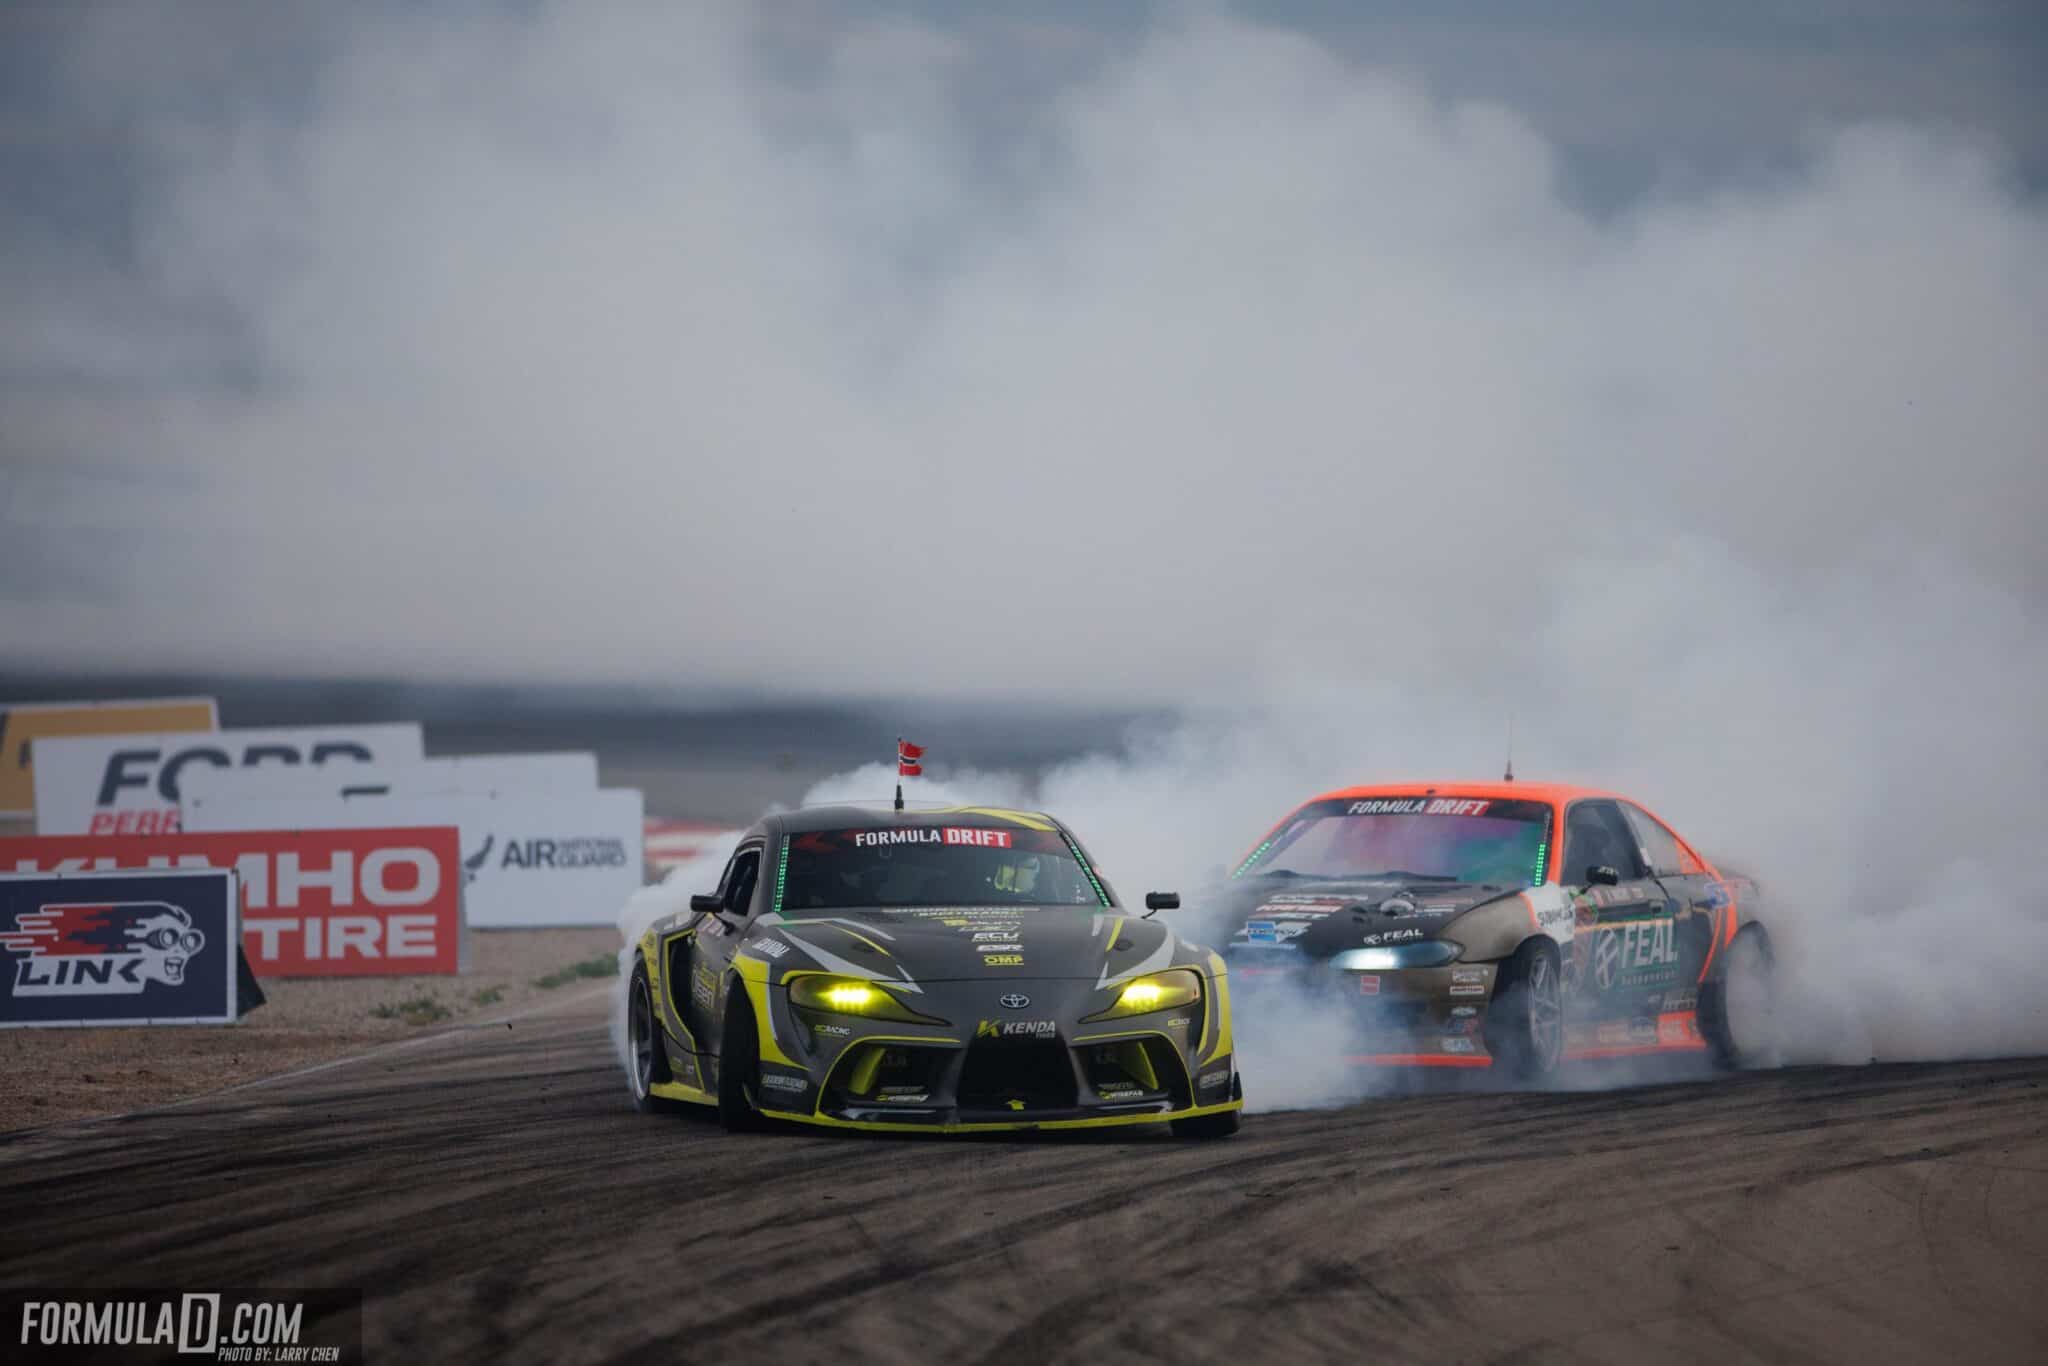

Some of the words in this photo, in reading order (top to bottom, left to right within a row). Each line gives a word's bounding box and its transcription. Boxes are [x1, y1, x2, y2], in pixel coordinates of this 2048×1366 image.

[1347, 800, 1427, 815] FORMULA
[1426, 799, 1489, 816] DRIFT
[855, 829, 941, 847] FORMULA
[946, 828, 1007, 847] DRIFT
[501, 838, 556, 869] AIR
[242, 914, 438, 961] TIRE
[1383, 929, 1424, 942] FEAL
[1622, 918, 1678, 968] FEAL
[983, 954, 1024, 966] OMP
[17, 958, 147, 987] LINK
[1003, 1021, 1056, 1035] KENDA
